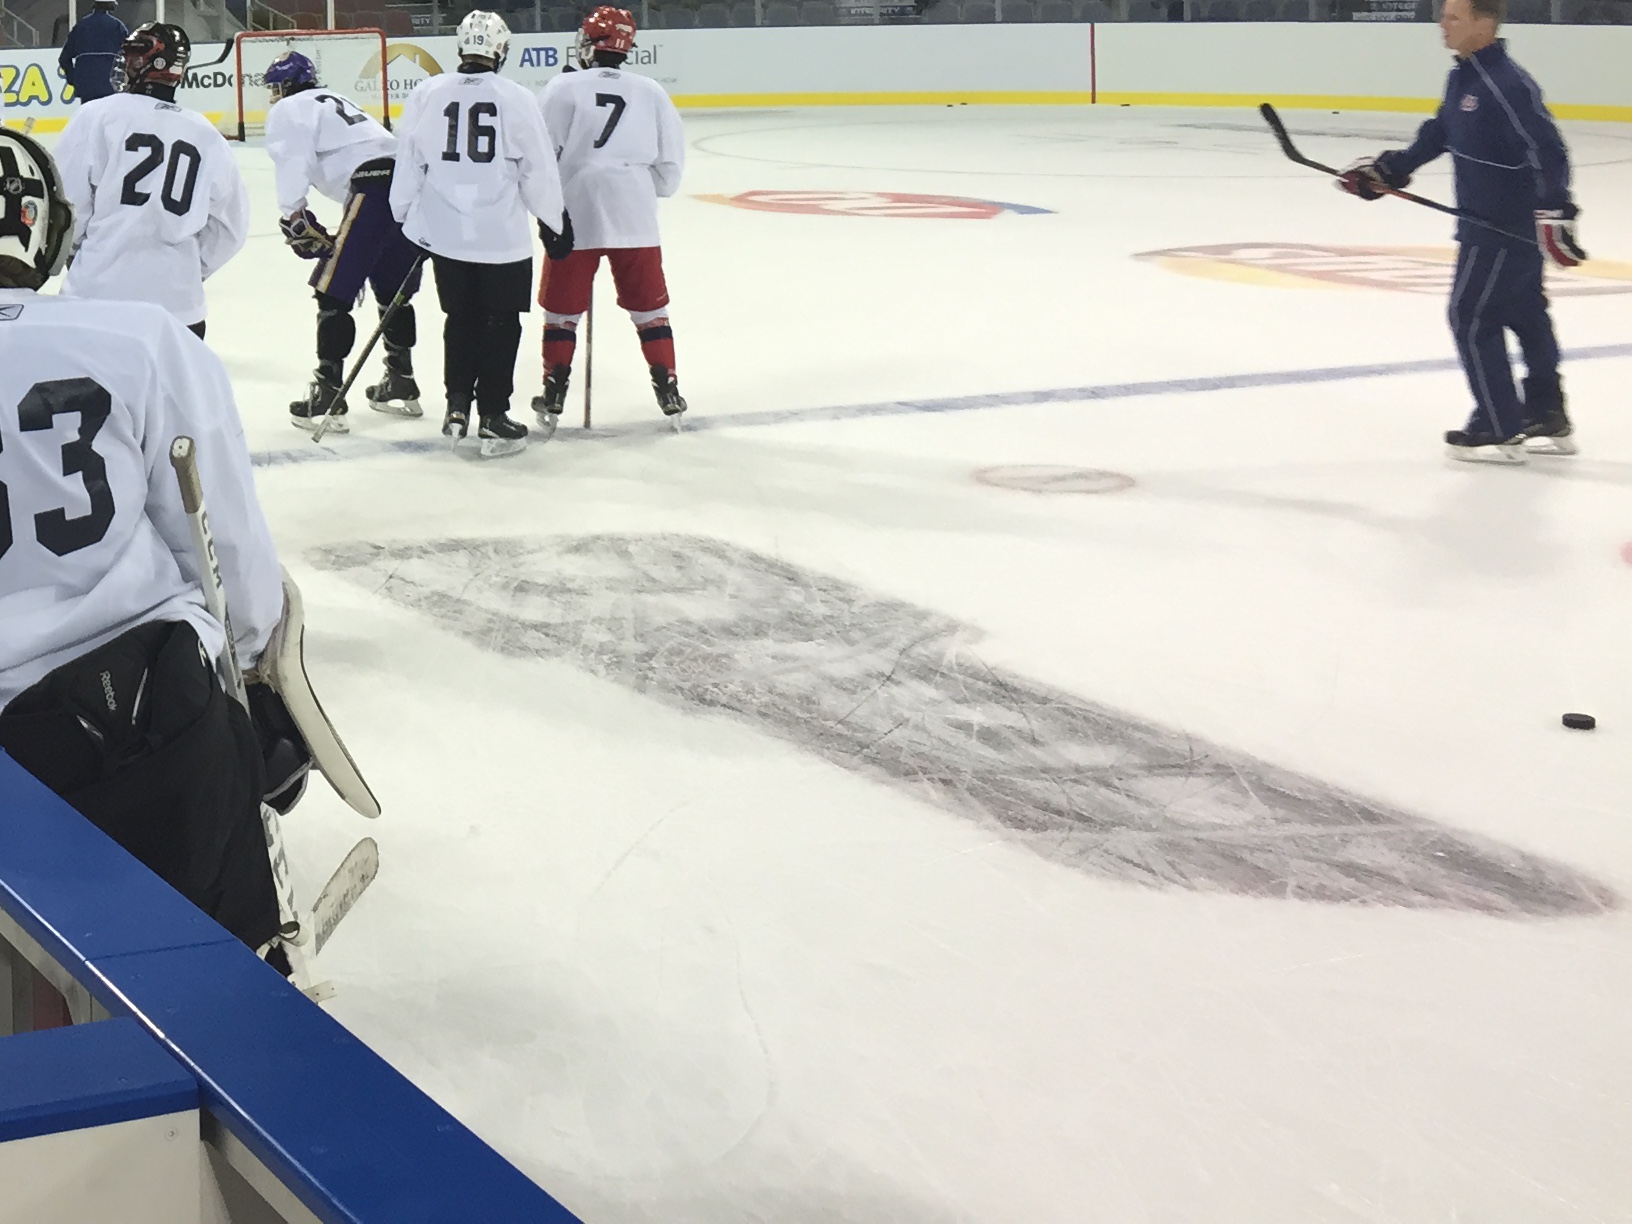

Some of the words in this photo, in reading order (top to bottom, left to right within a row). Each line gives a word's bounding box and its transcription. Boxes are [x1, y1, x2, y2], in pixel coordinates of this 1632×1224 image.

[518, 46, 559, 68] ATB
[441, 100, 498, 164] 16
[593, 92, 627, 149] 7
[119, 132, 203, 217] 20
[200, 510, 225, 590] CCM
[99, 670, 118, 712] Reebok
